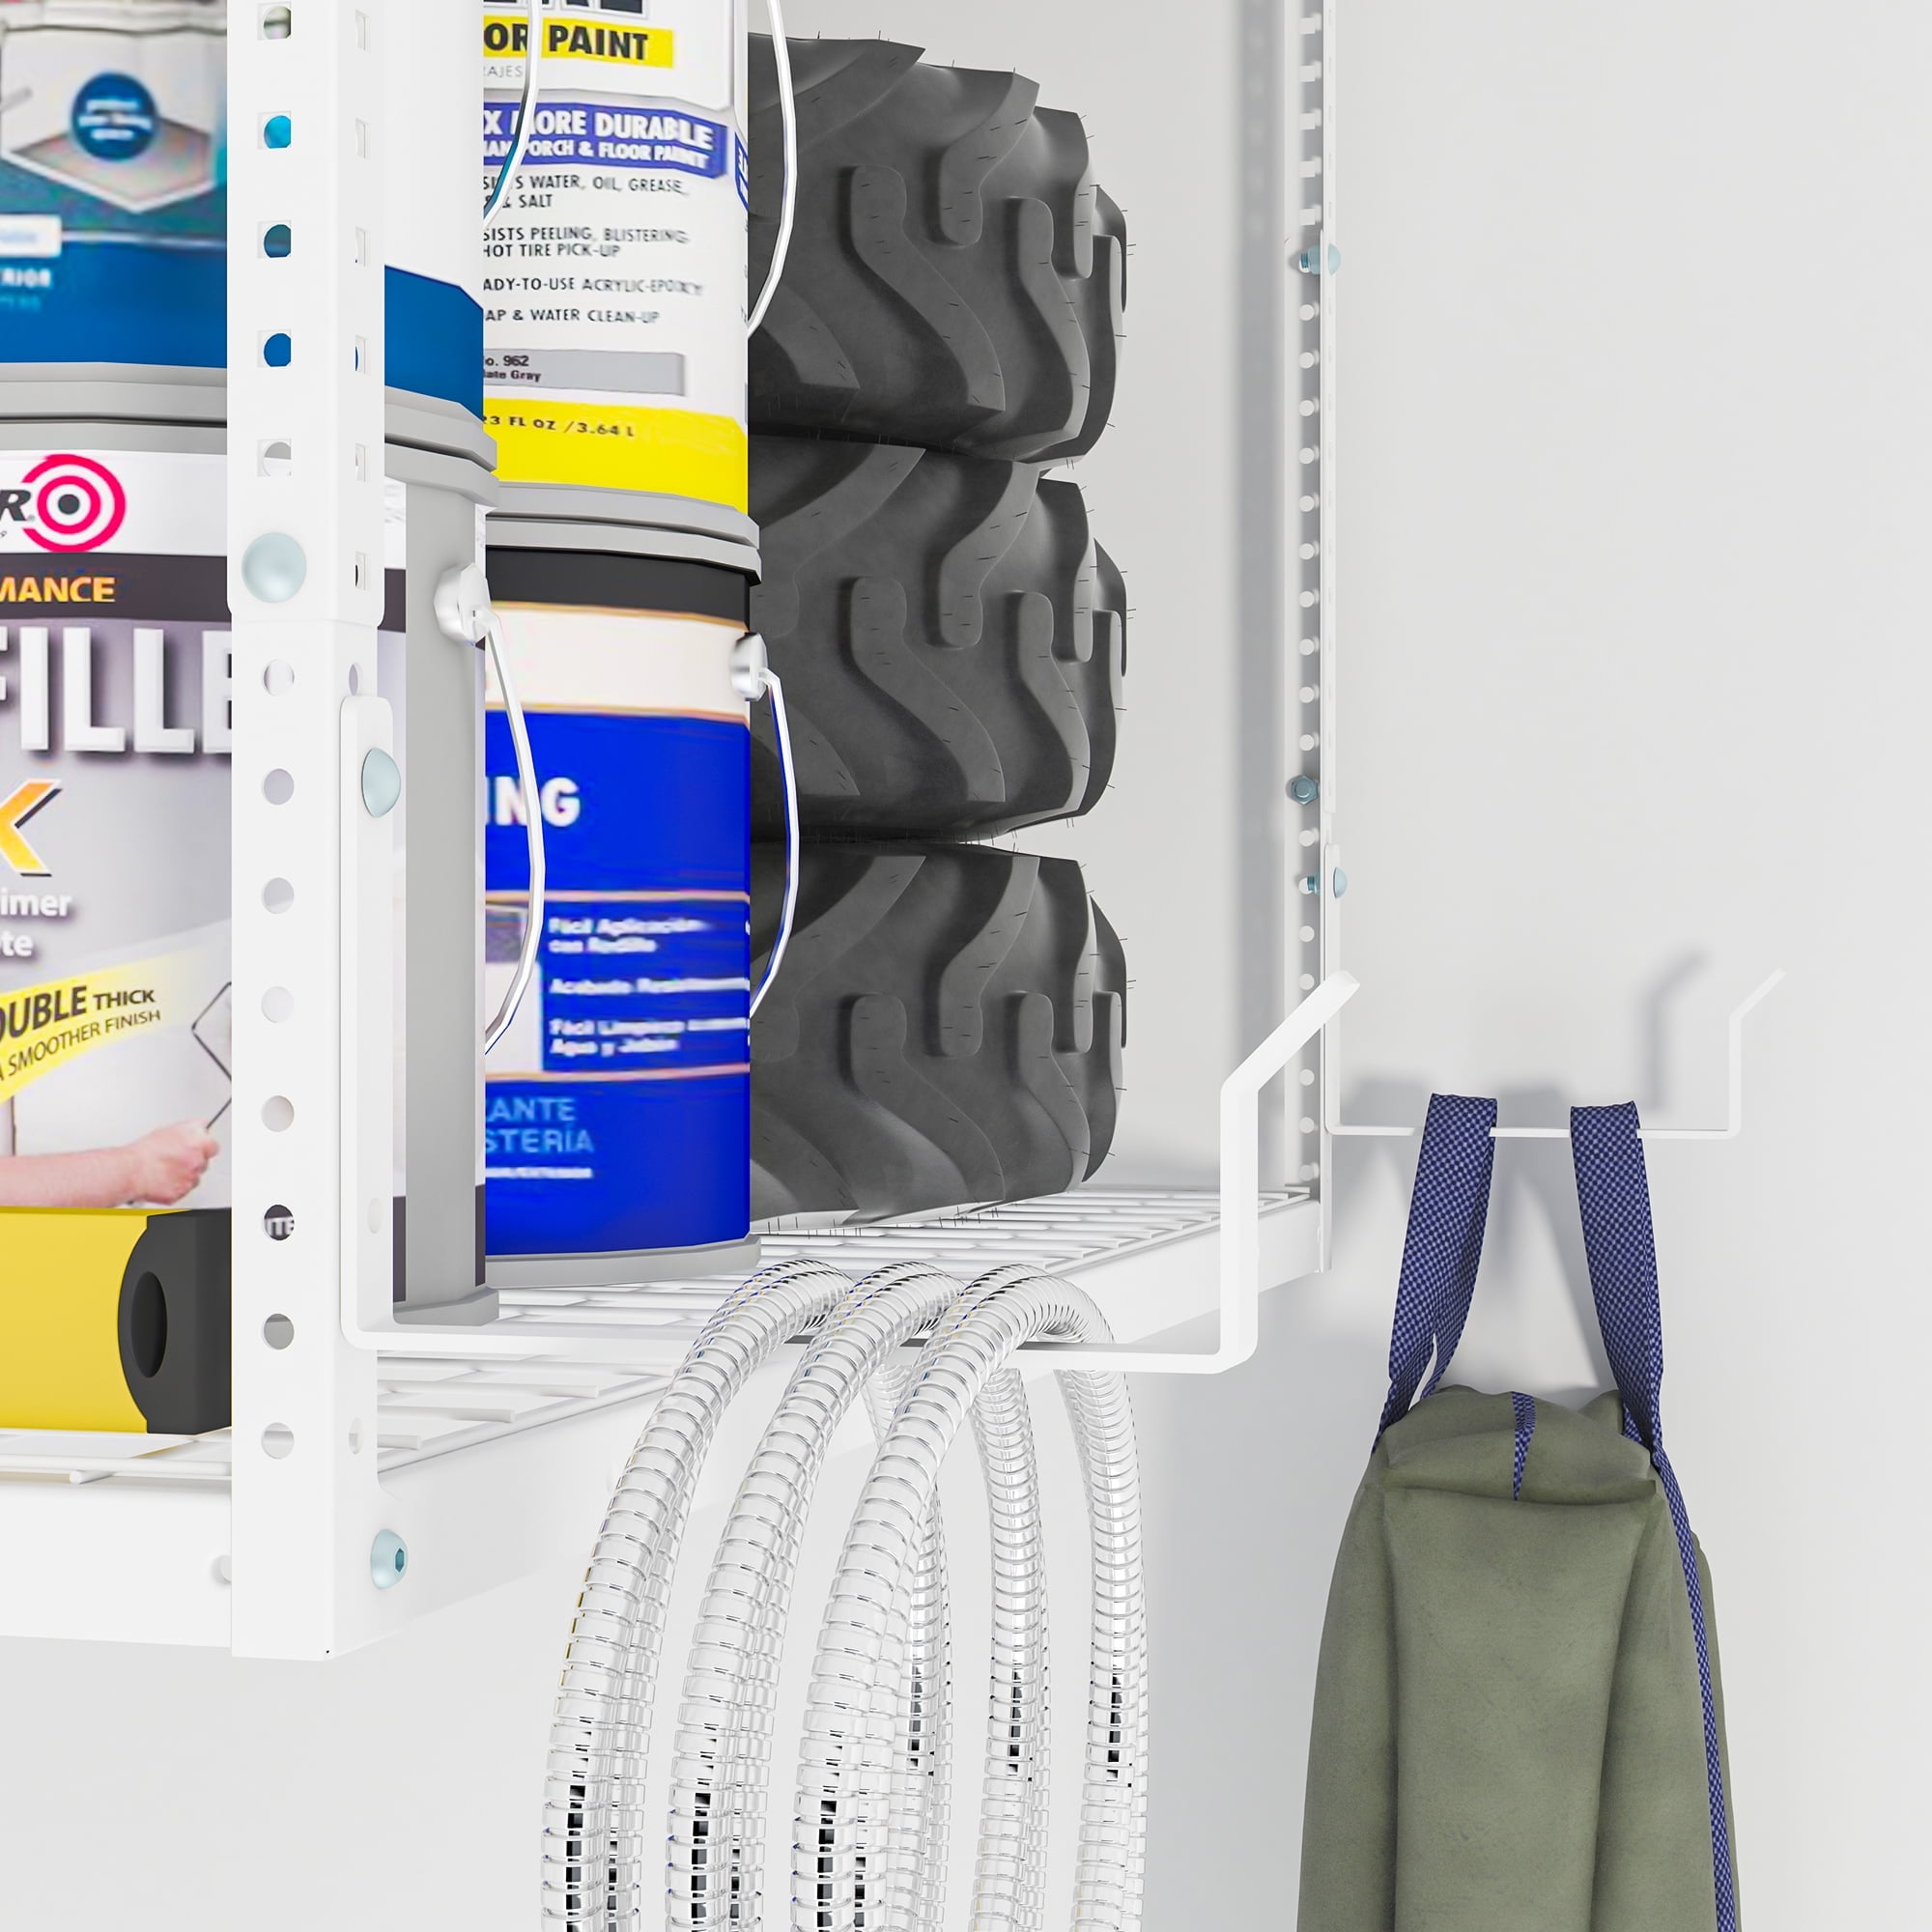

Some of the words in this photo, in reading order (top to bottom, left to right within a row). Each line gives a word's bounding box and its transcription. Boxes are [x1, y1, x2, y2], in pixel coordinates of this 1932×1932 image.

[549, 24, 649, 61] PAINT
[594, 111, 715, 151] DURABLE
[523, 139, 576, 157] ORCH
[578, 141, 594, 156] &
[598, 142, 653, 160] FLOOR
[518, 193, 553, 209] SALT
[519, 242, 552, 257] TIRE
[556, 242, 621, 258] PICK-UP
[483, 276, 575, 291] ADY-TO-USE
[485, 309, 507, 322] AP
[512, 309, 524, 321] &
[529, 308, 581, 322] WATER
[586, 309, 660, 324] CLEAN-UP
[508, 415, 526, 427] FL
[0, 625, 232, 754] ILLE
[0, 930, 35, 957] te
[0, 984, 88, 1044] UBLE
[92, 989, 156, 1011] THICK
[8, 1020, 101, 1077] SMOOTHER
[104, 1009, 162, 1034] FINISH
[485, 1096, 577, 1122] ANTE
